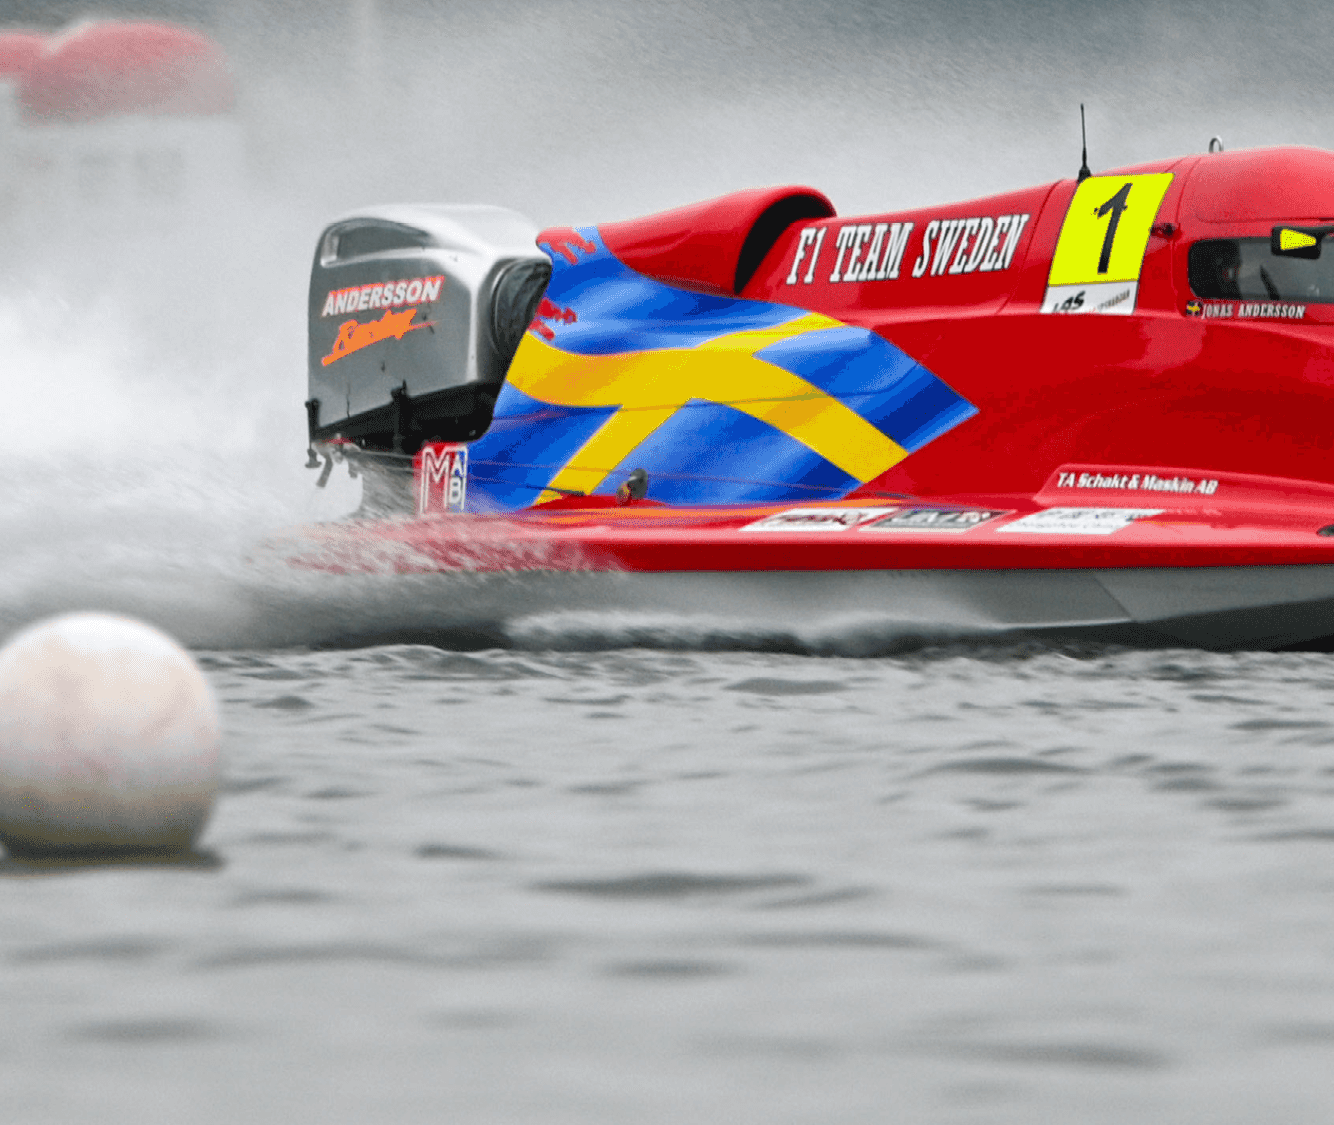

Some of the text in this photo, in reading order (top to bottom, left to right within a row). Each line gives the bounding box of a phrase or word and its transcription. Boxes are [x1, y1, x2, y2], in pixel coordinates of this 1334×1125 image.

[785, 213, 1030, 285] F1 TEAM SWEDEN
[1093, 182, 1133, 275] 1
[320, 274, 446, 317] ANDERSSON
[1200, 303, 1306, 319] JONAS ANDERSSON
[1057, 472, 1076, 488] TA
[1076, 472, 1128, 489] Schakt
[1127, 473, 1140, 490] &
[1195, 479, 1219, 495] AB
